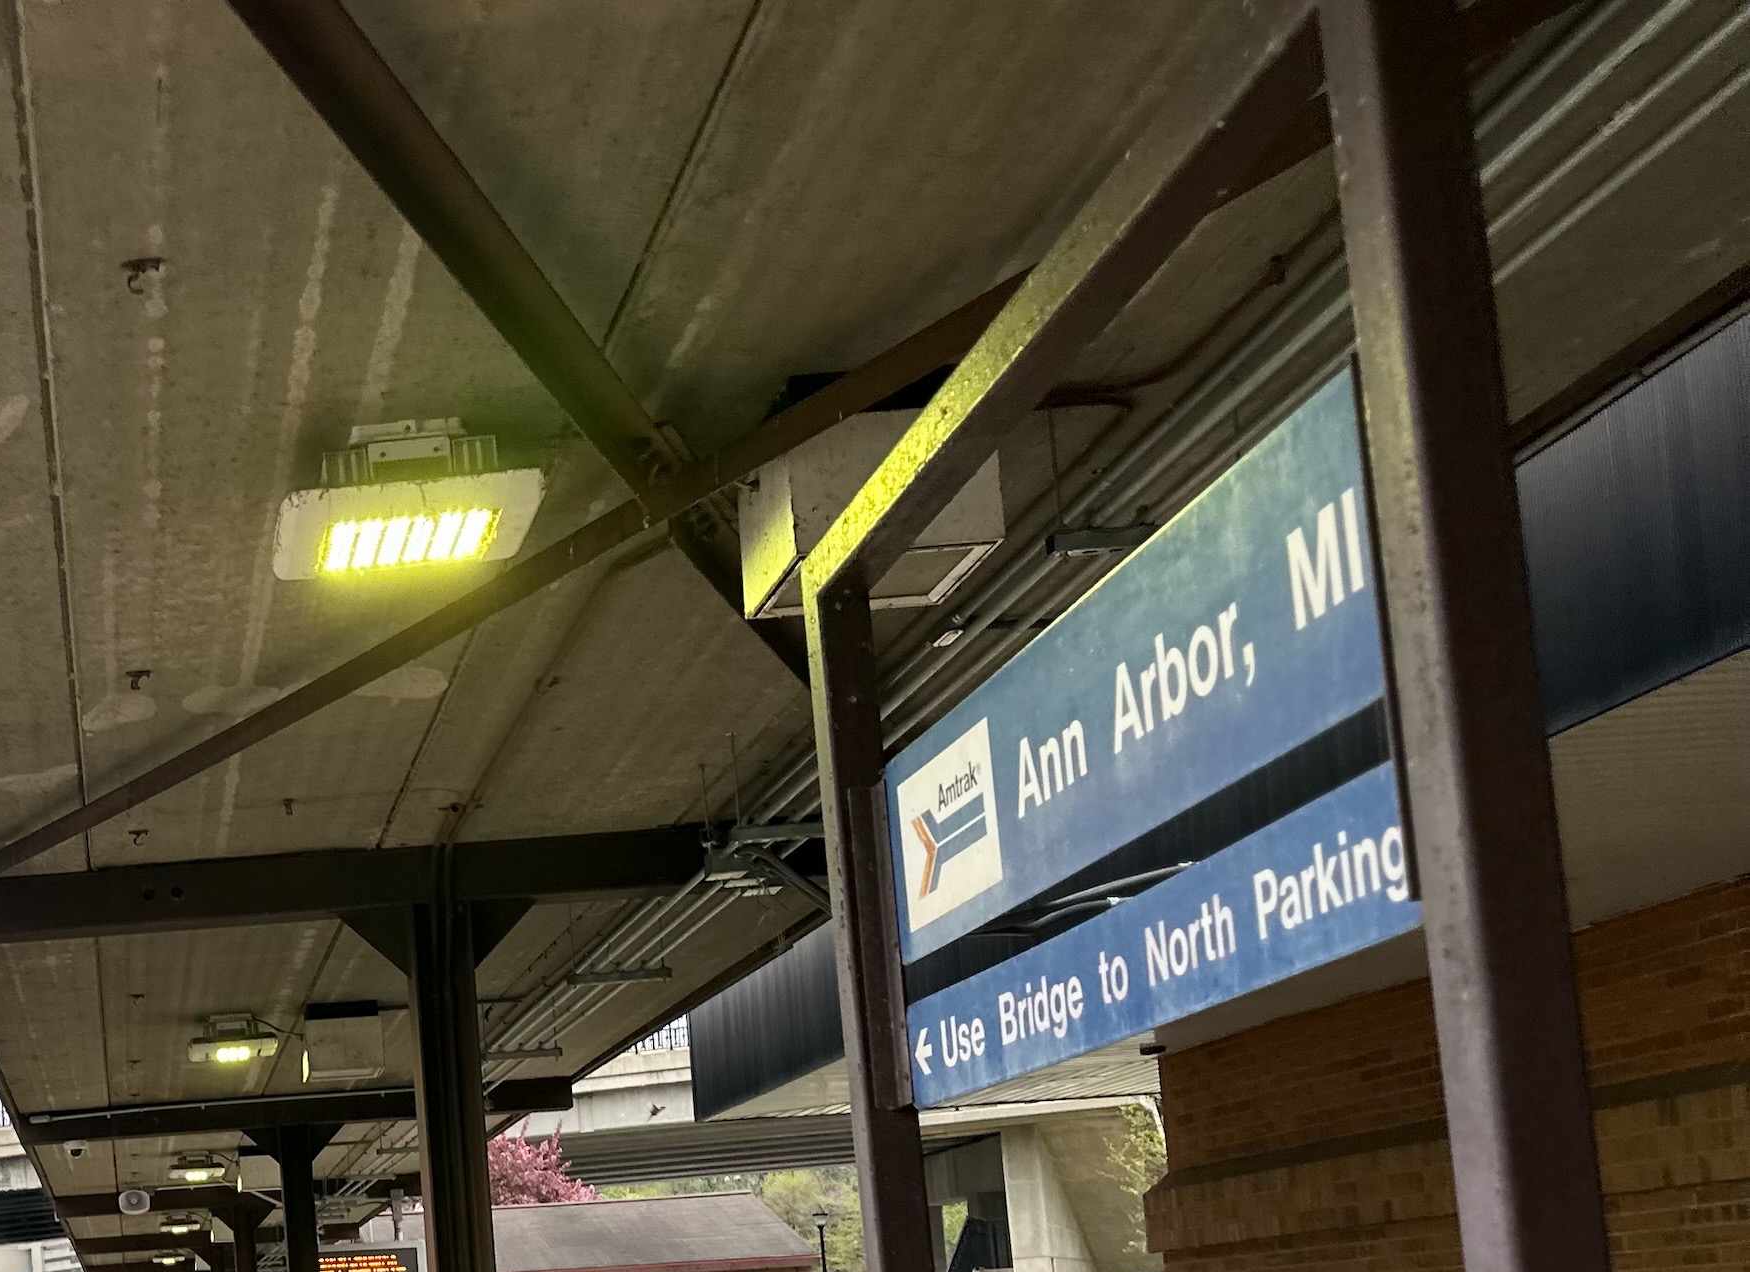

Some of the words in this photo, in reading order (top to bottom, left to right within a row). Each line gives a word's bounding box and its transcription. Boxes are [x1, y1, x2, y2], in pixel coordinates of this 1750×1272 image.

[1018, 720, 1088, 818] Ann
[1114, 602, 1256, 754] Arbor,
[1286, 487, 1365, 631] MI
[938, 761, 978, 812] Amtrak
[940, 1015, 986, 1068] Use
[999, 974, 1084, 1046] Bridge
[1099, 950, 1129, 1005] to
[1145, 894, 1238, 988] North
[1253, 826, 1409, 940] Parking
